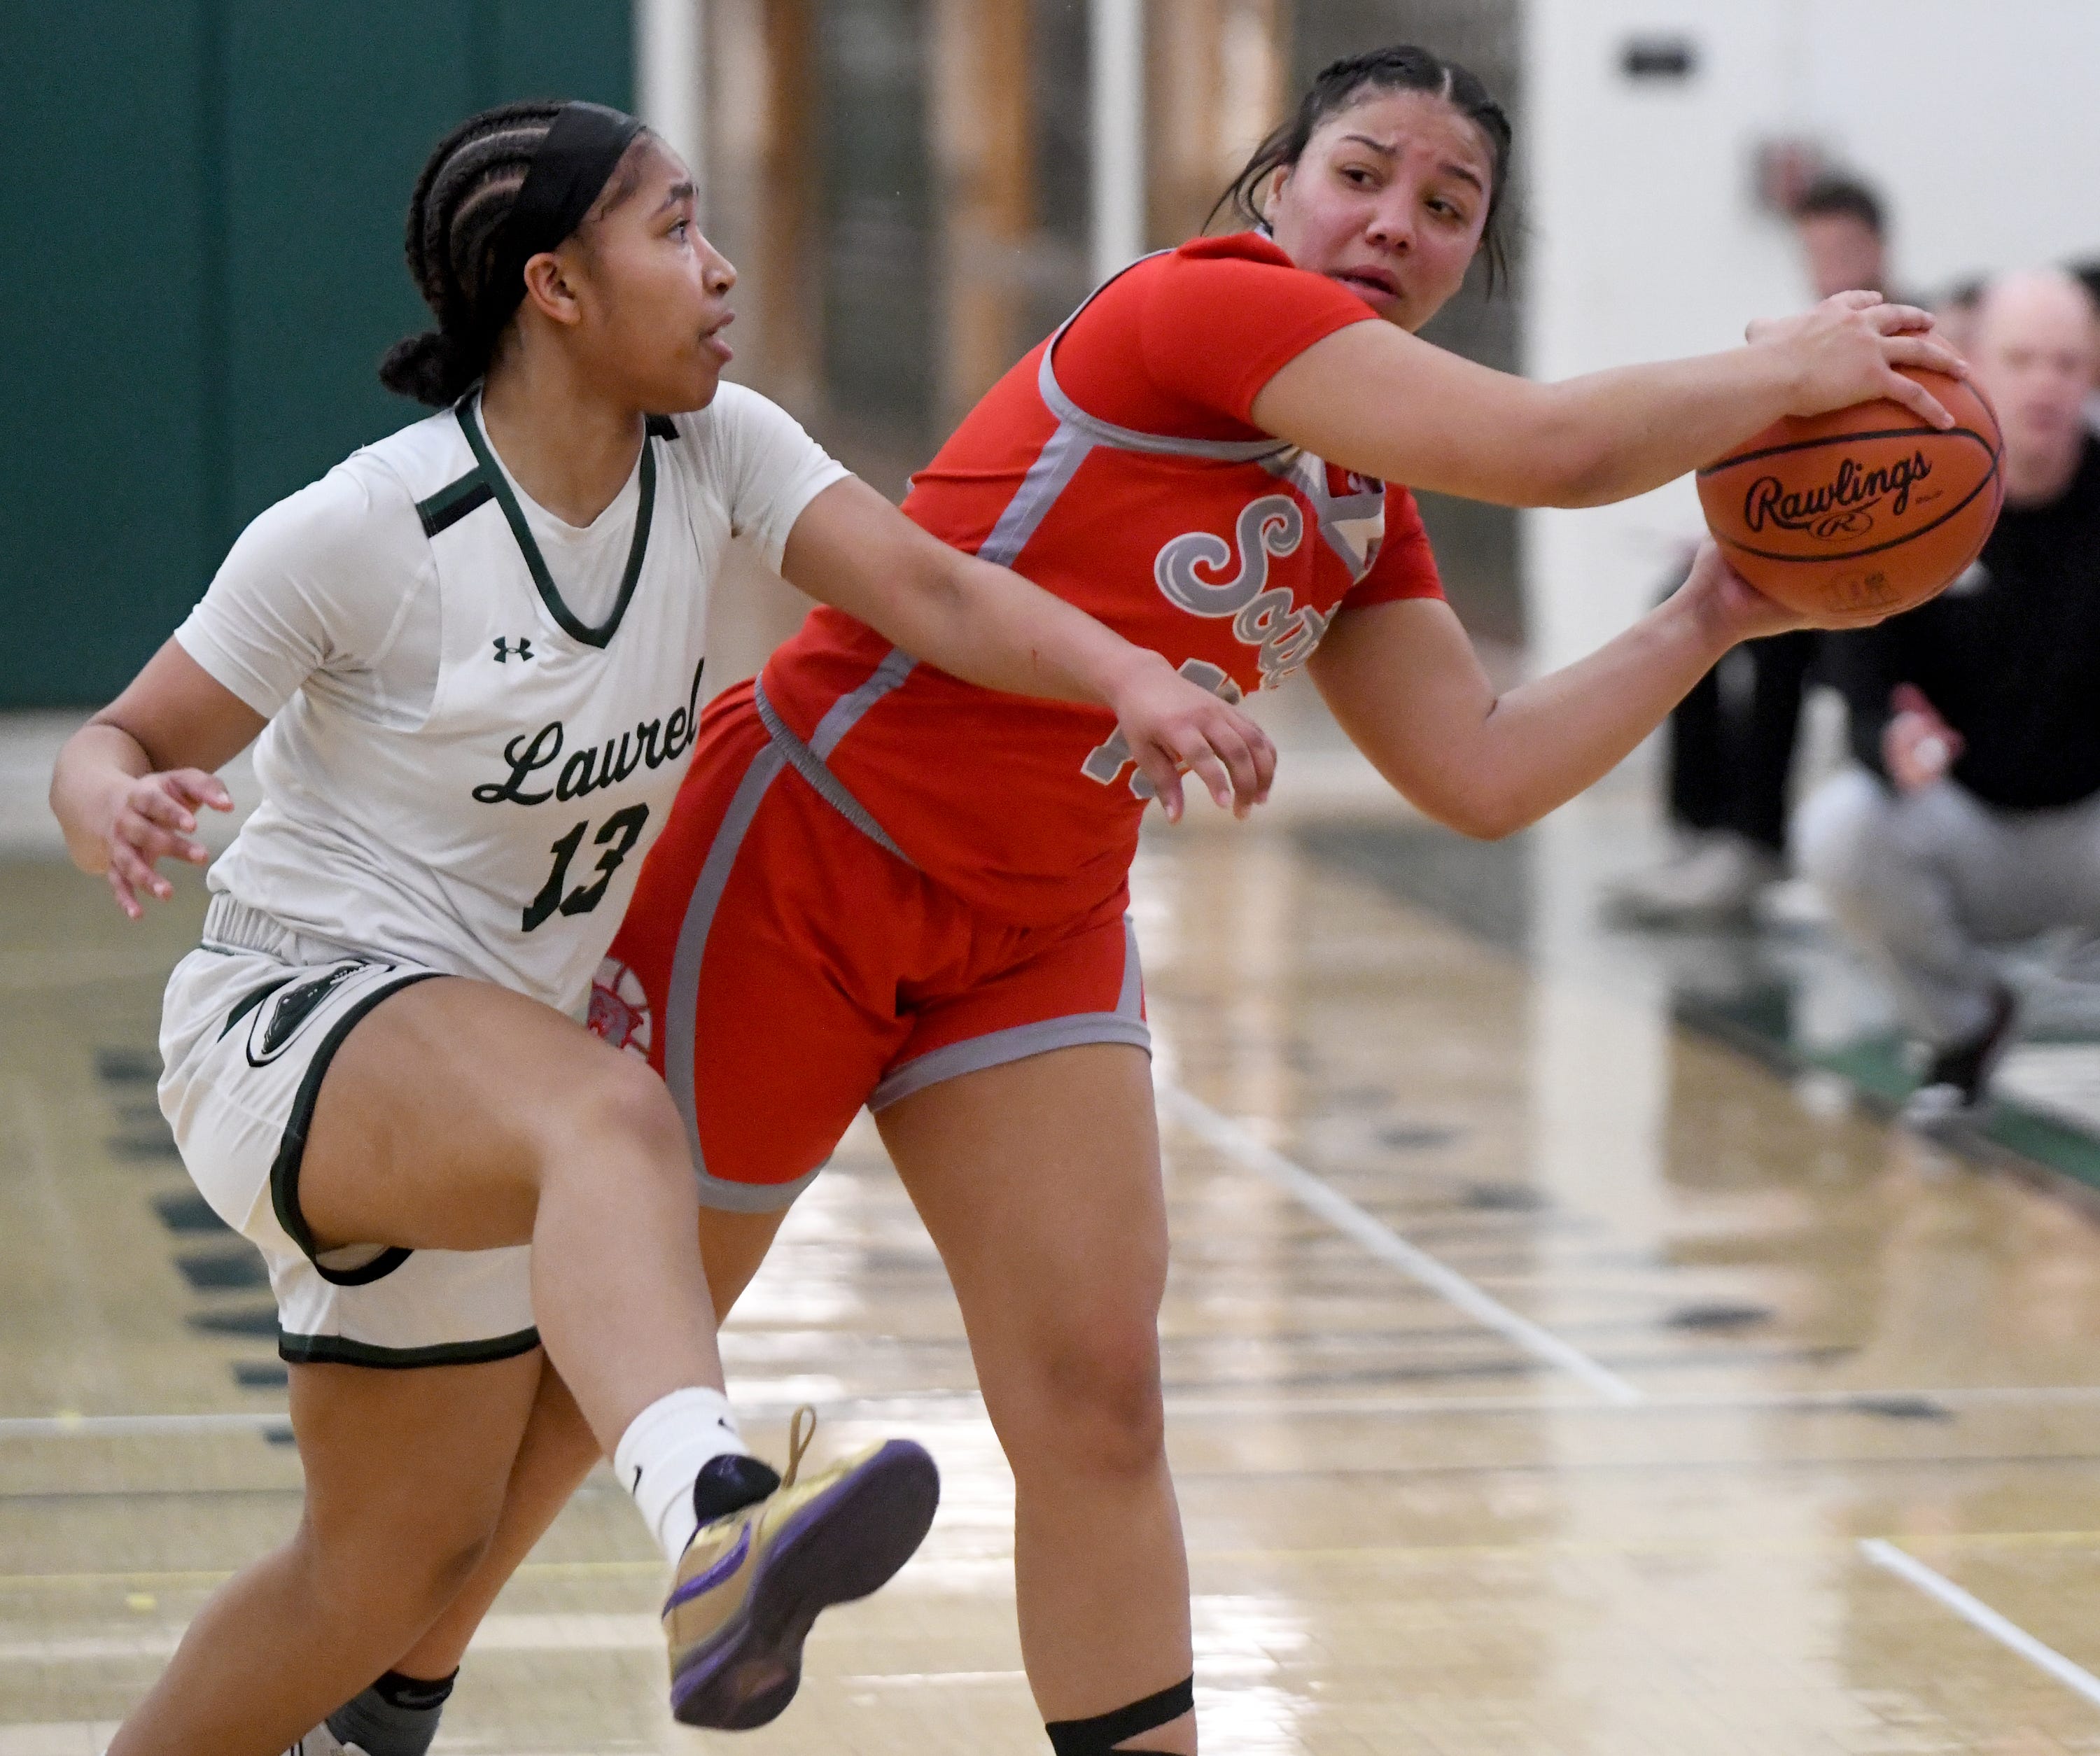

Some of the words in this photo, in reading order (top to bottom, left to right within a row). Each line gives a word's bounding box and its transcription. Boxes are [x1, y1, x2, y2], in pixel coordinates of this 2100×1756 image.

[1744, 450, 1932, 533] Rawlings
[472, 656, 704, 806] Laurel
[522, 802, 650, 932] 13
